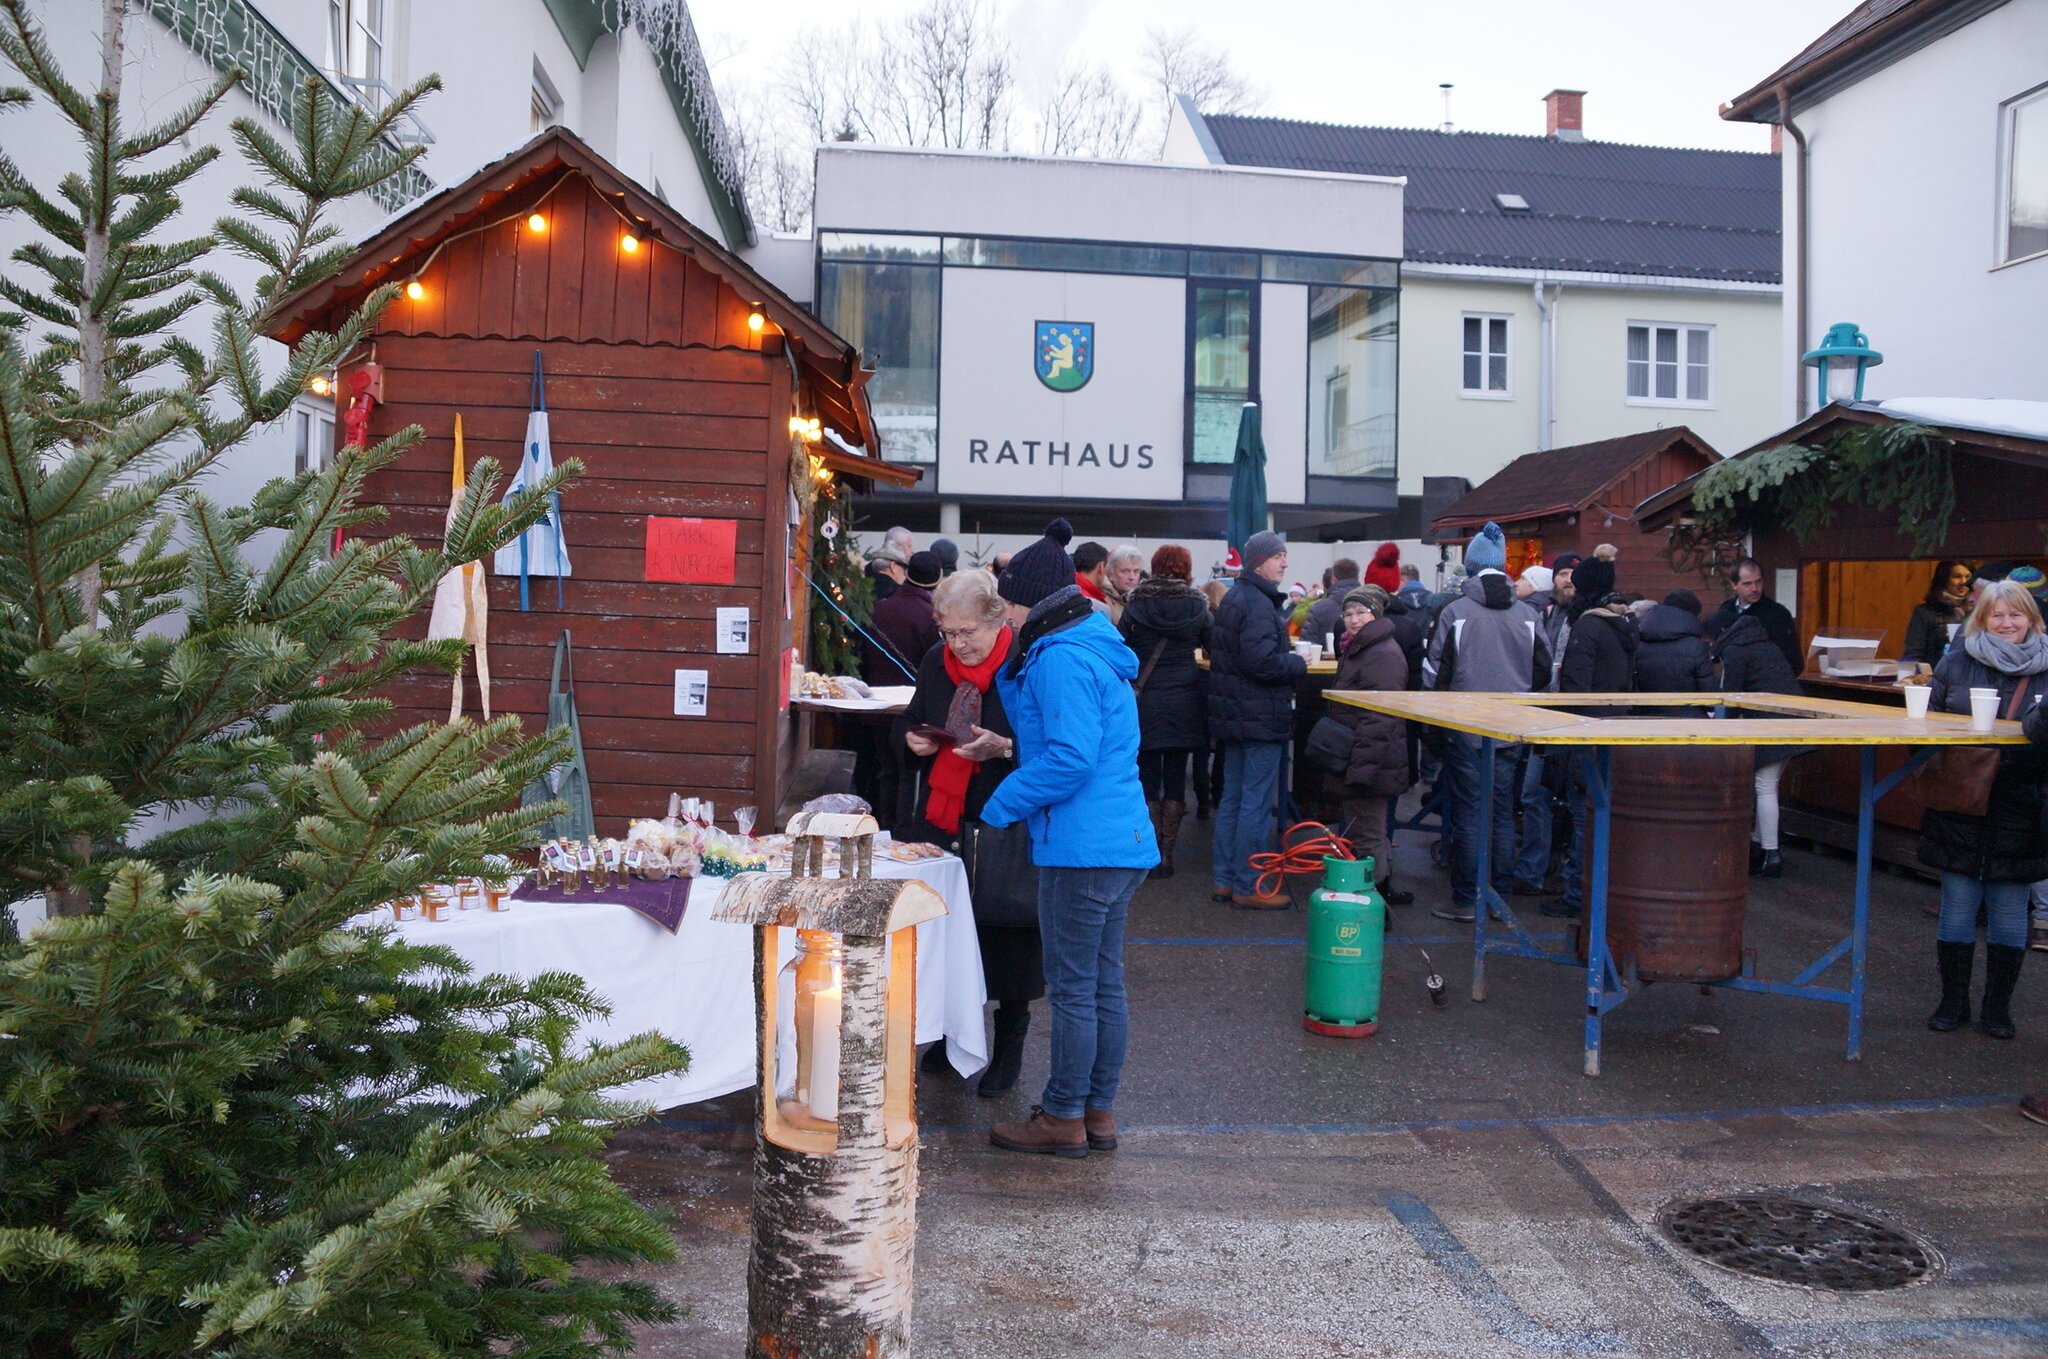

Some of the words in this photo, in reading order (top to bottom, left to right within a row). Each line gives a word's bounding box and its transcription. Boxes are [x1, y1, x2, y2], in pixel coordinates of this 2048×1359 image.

[969, 438, 1154, 470] RATHAUS
[656, 523, 722, 547] PFARRE
[652, 551, 729, 577] KINDBERG
[1340, 926, 1358, 939] BP
